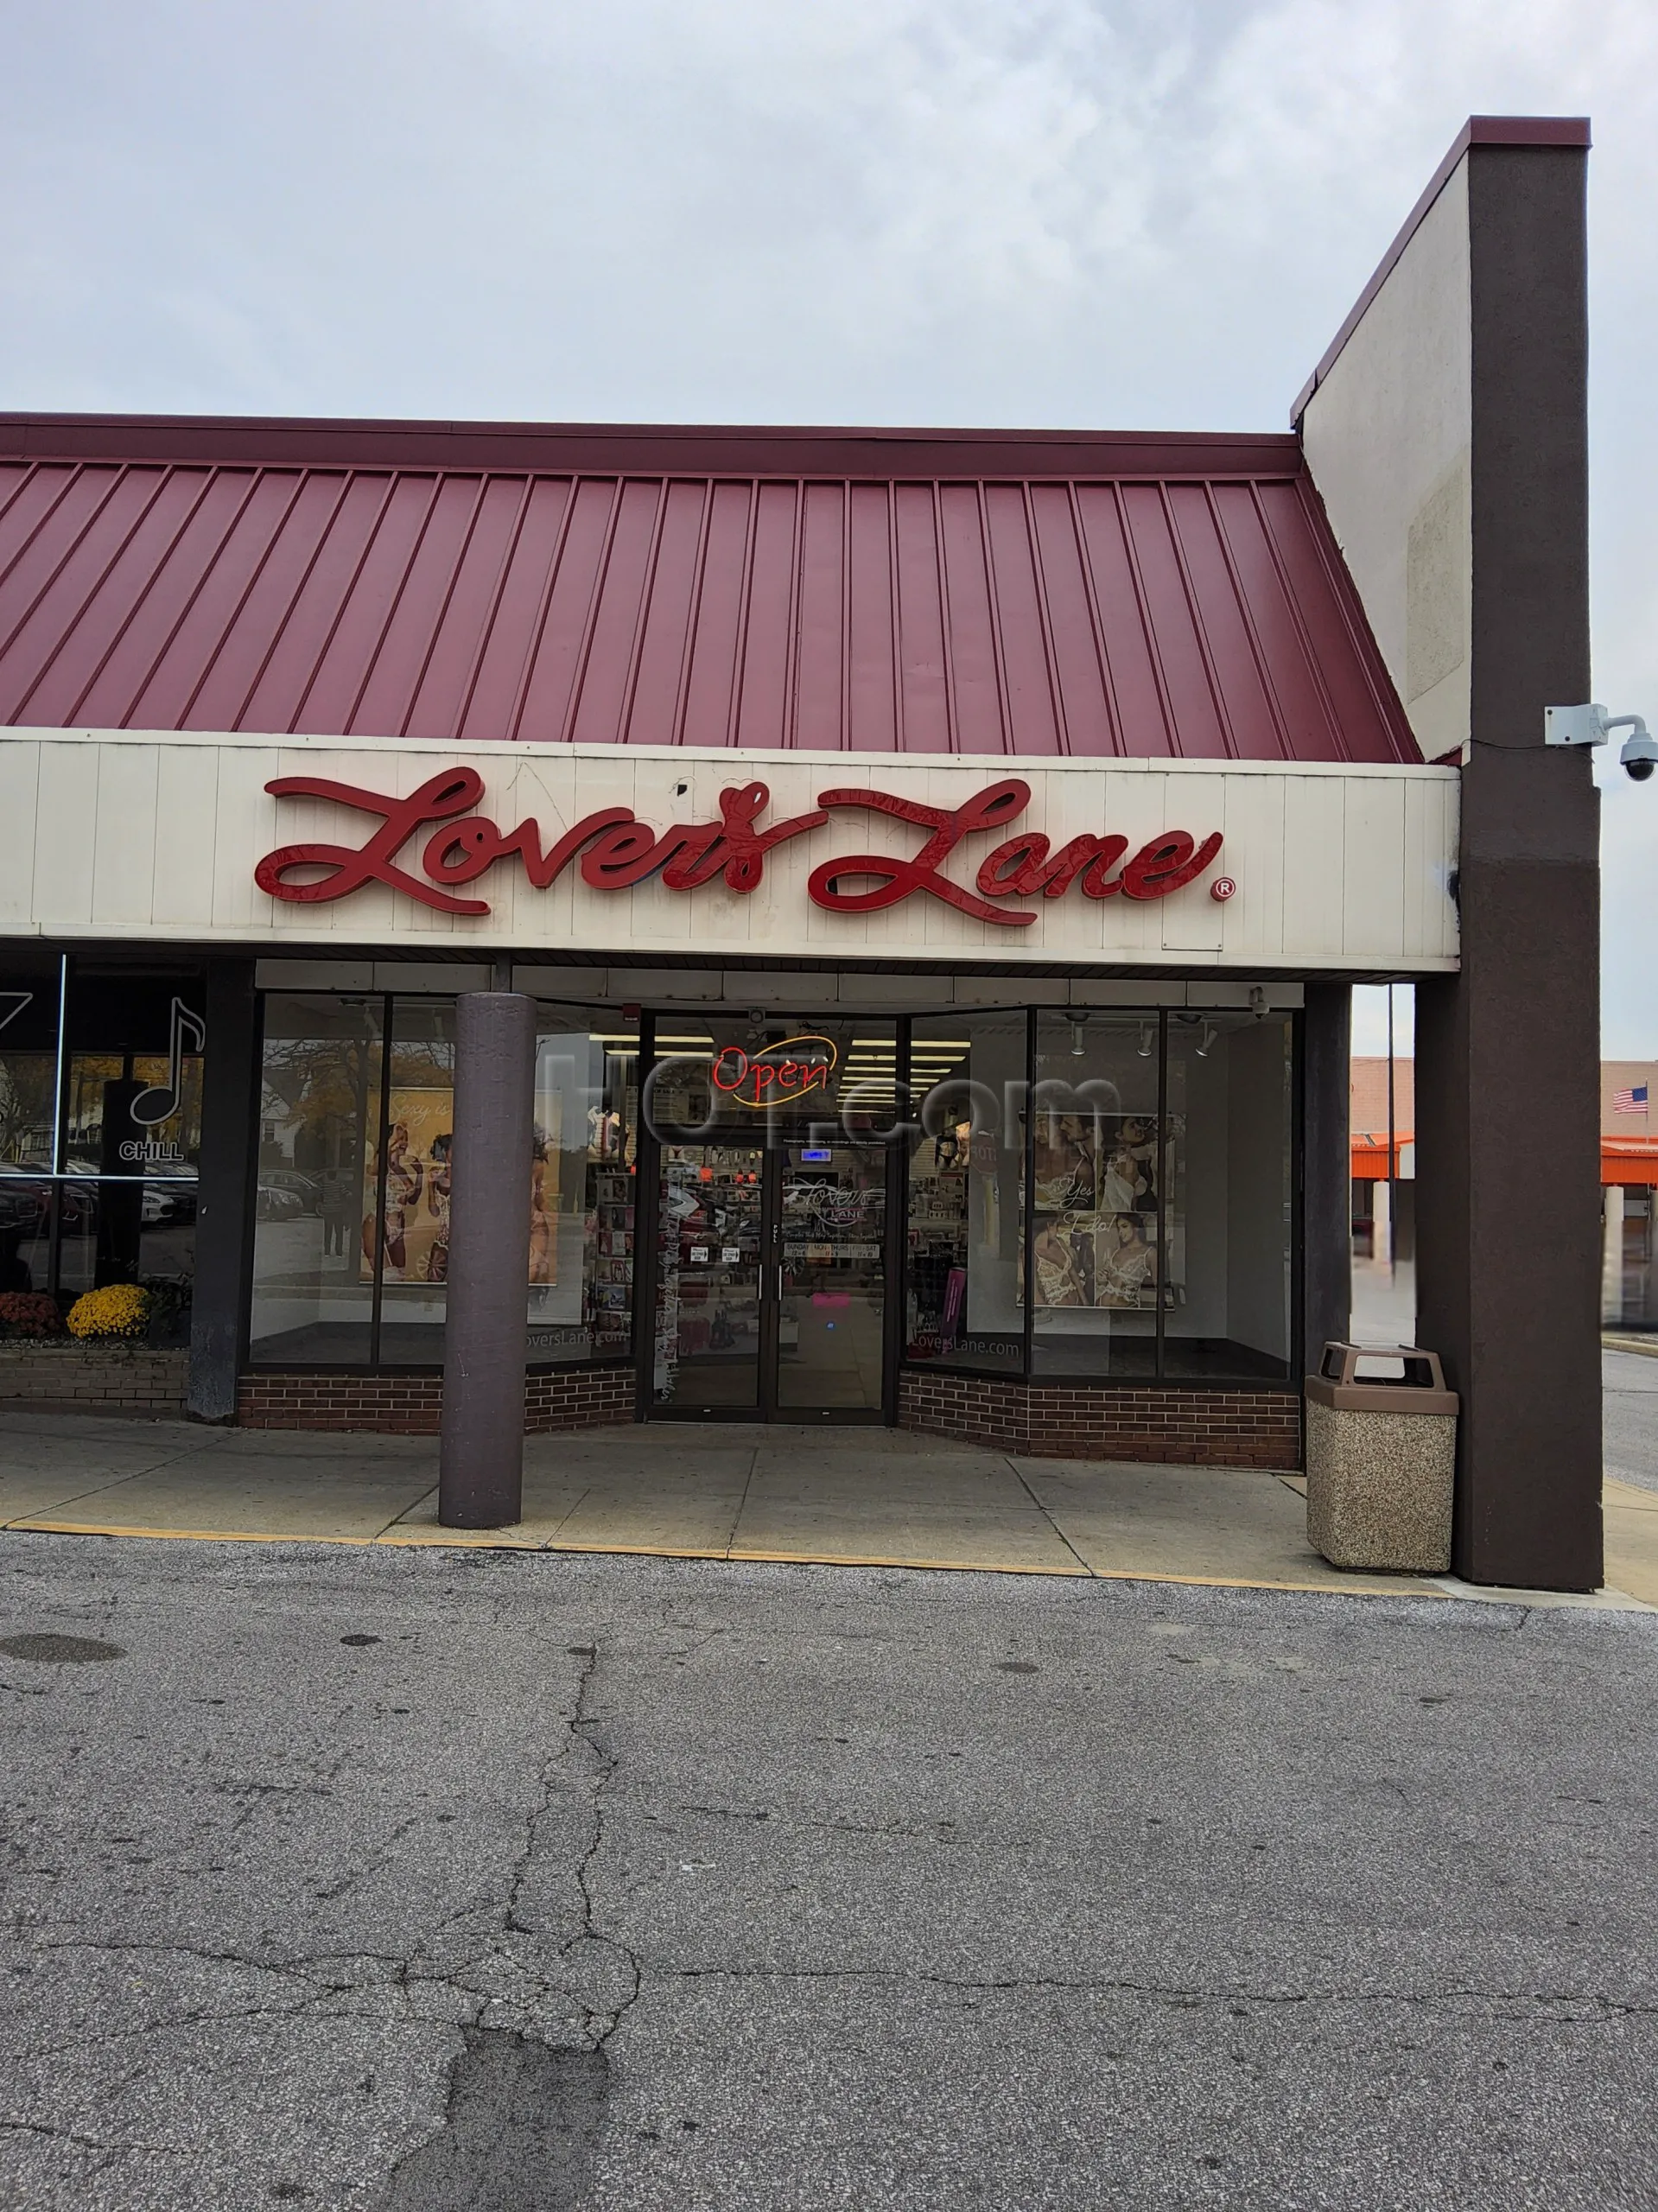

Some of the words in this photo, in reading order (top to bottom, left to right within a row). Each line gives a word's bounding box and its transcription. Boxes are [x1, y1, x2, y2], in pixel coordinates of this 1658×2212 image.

[808, 779, 1223, 927] Lane
[713, 1046, 828, 1103] Open
[390, 1093, 431, 1127] Sexy
[435, 1103, 450, 1116] is
[119, 1141, 184, 1161] CHILL
[1059, 1178, 1095, 1209] Yes
[1085, 1214, 1117, 1233] do!
[525, 1328, 626, 1348] oversLane.com
[912, 1332, 1020, 1357] LoversLane.com
